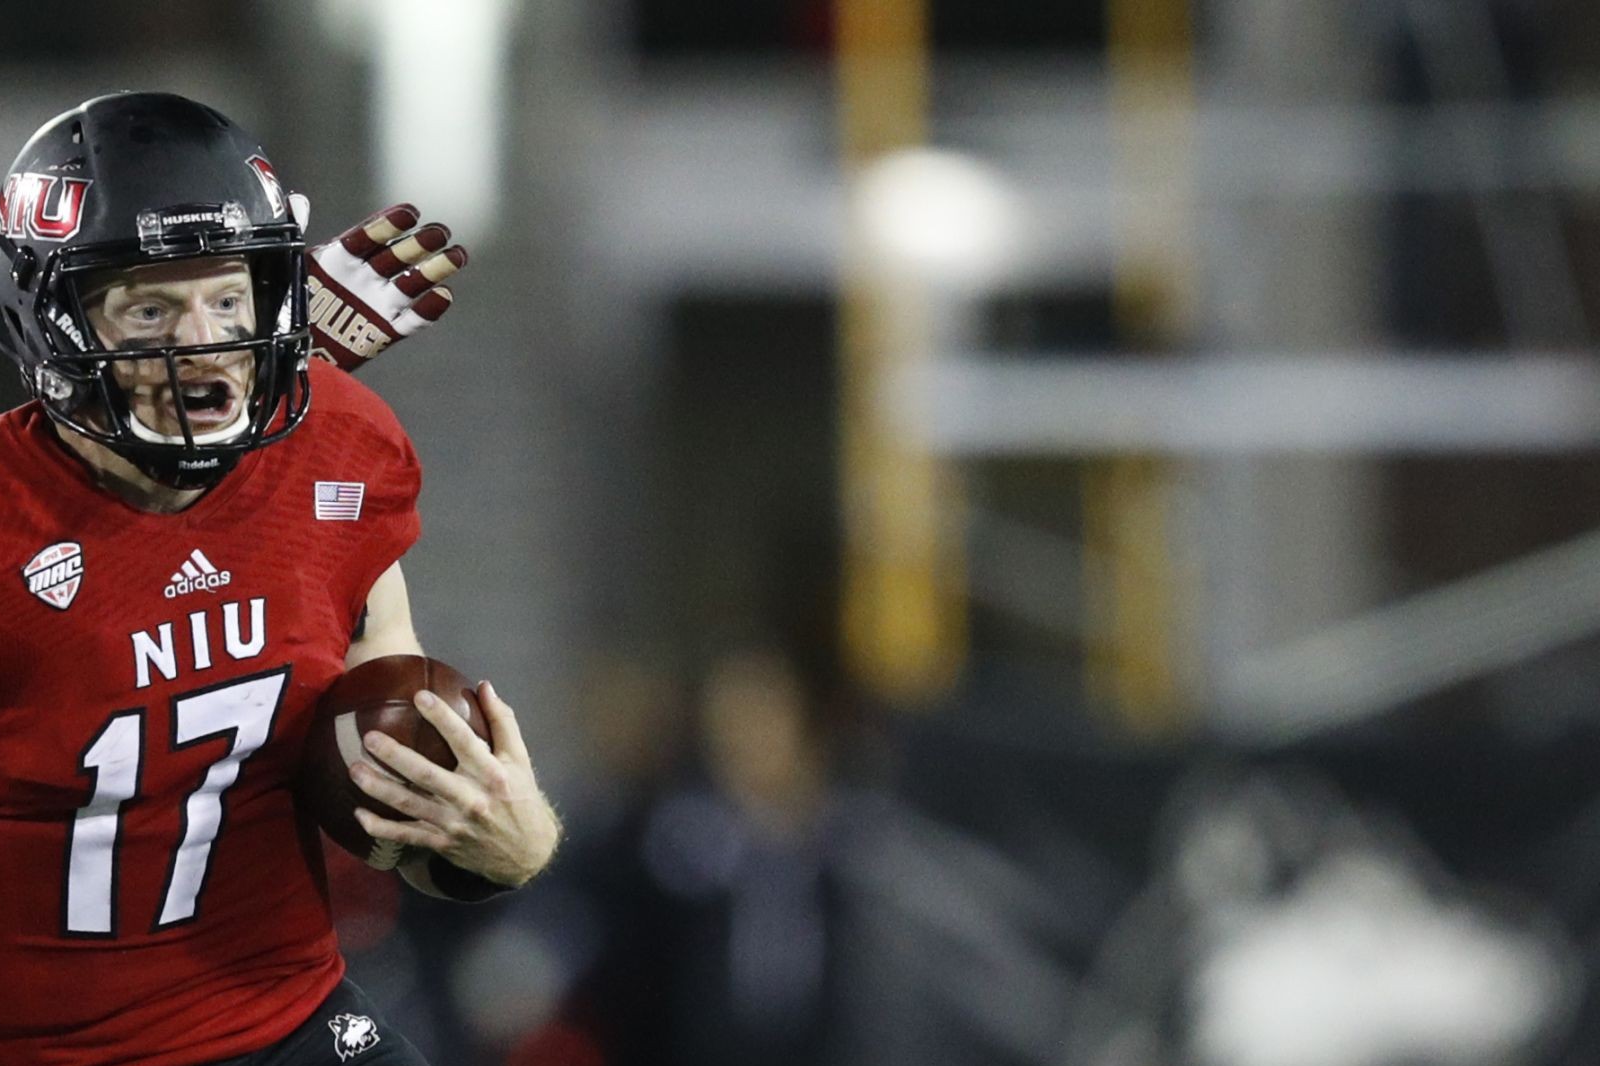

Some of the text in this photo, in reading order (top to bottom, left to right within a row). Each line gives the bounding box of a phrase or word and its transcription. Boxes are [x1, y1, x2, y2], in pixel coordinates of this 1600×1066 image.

[162, 212, 224, 226] HUSKIES
[178, 457, 220, 470] Riddell
[28, 555, 84, 595] MAC
[163, 570, 231, 599] adidas
[131, 597, 266, 688] NIU
[63, 662, 292, 940] 17
